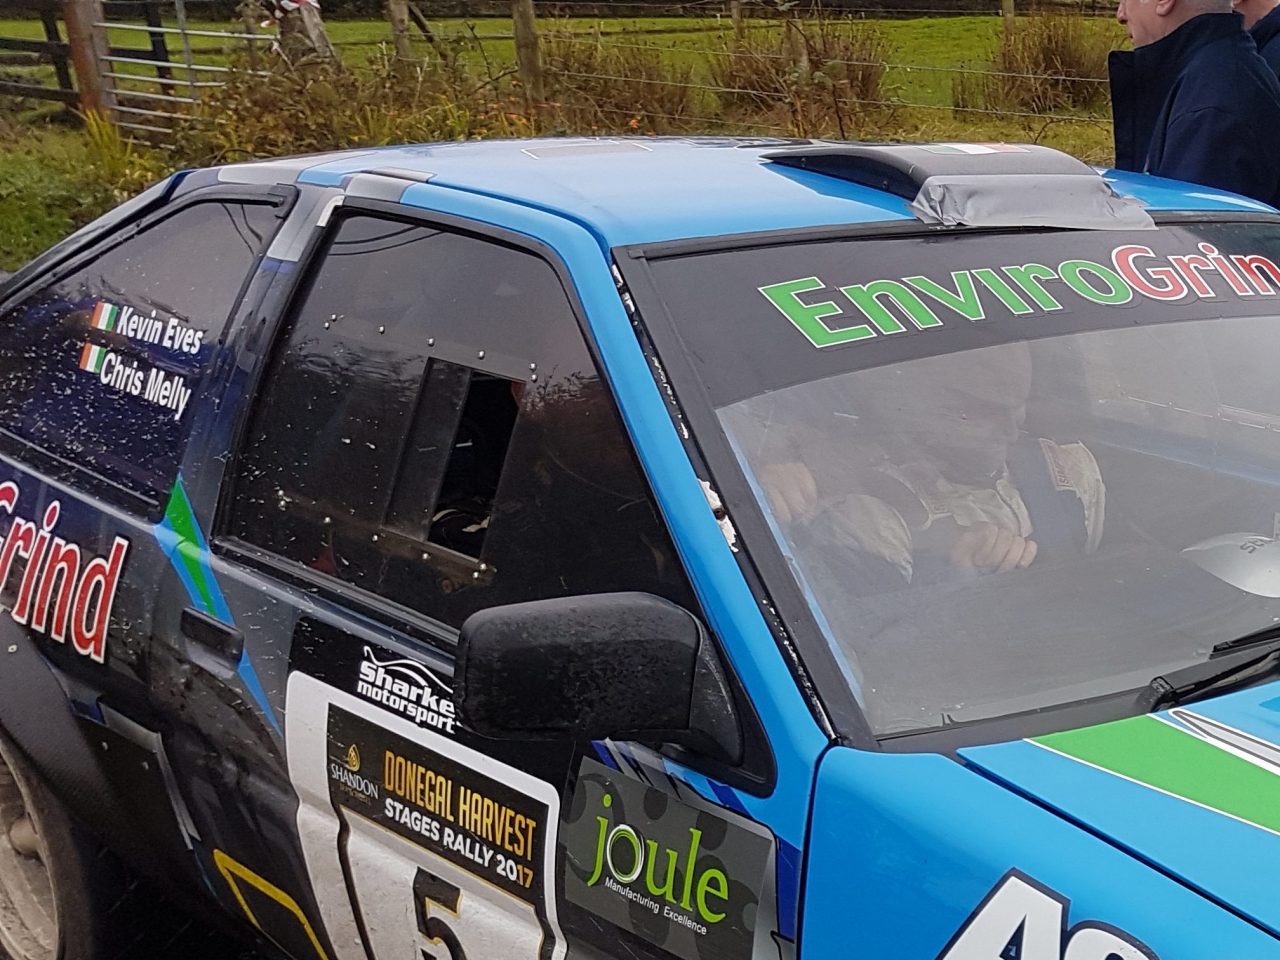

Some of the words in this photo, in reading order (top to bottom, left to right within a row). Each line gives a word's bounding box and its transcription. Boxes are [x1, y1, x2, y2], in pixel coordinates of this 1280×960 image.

[117, 306, 163, 344] Kevin
[162, 317, 203, 354] Eves
[100, 352, 144, 396] Chris
[144, 368, 192, 421] Melly
[357, 680, 456, 735] motorsport
[359, 660, 456, 718] Sharke
[331, 763, 379, 800] SHANDON
[384, 750, 455, 823] DONEGAL
[459, 786, 537, 861] HARVEST
[384, 798, 440, 842] STAGES
[443, 829, 494, 868] RALLY
[496, 853, 534, 889] 2017
[587, 793, 729, 923] joule
[604, 876, 660, 914] Manufacturing
[663, 906, 707, 936] Excellence
